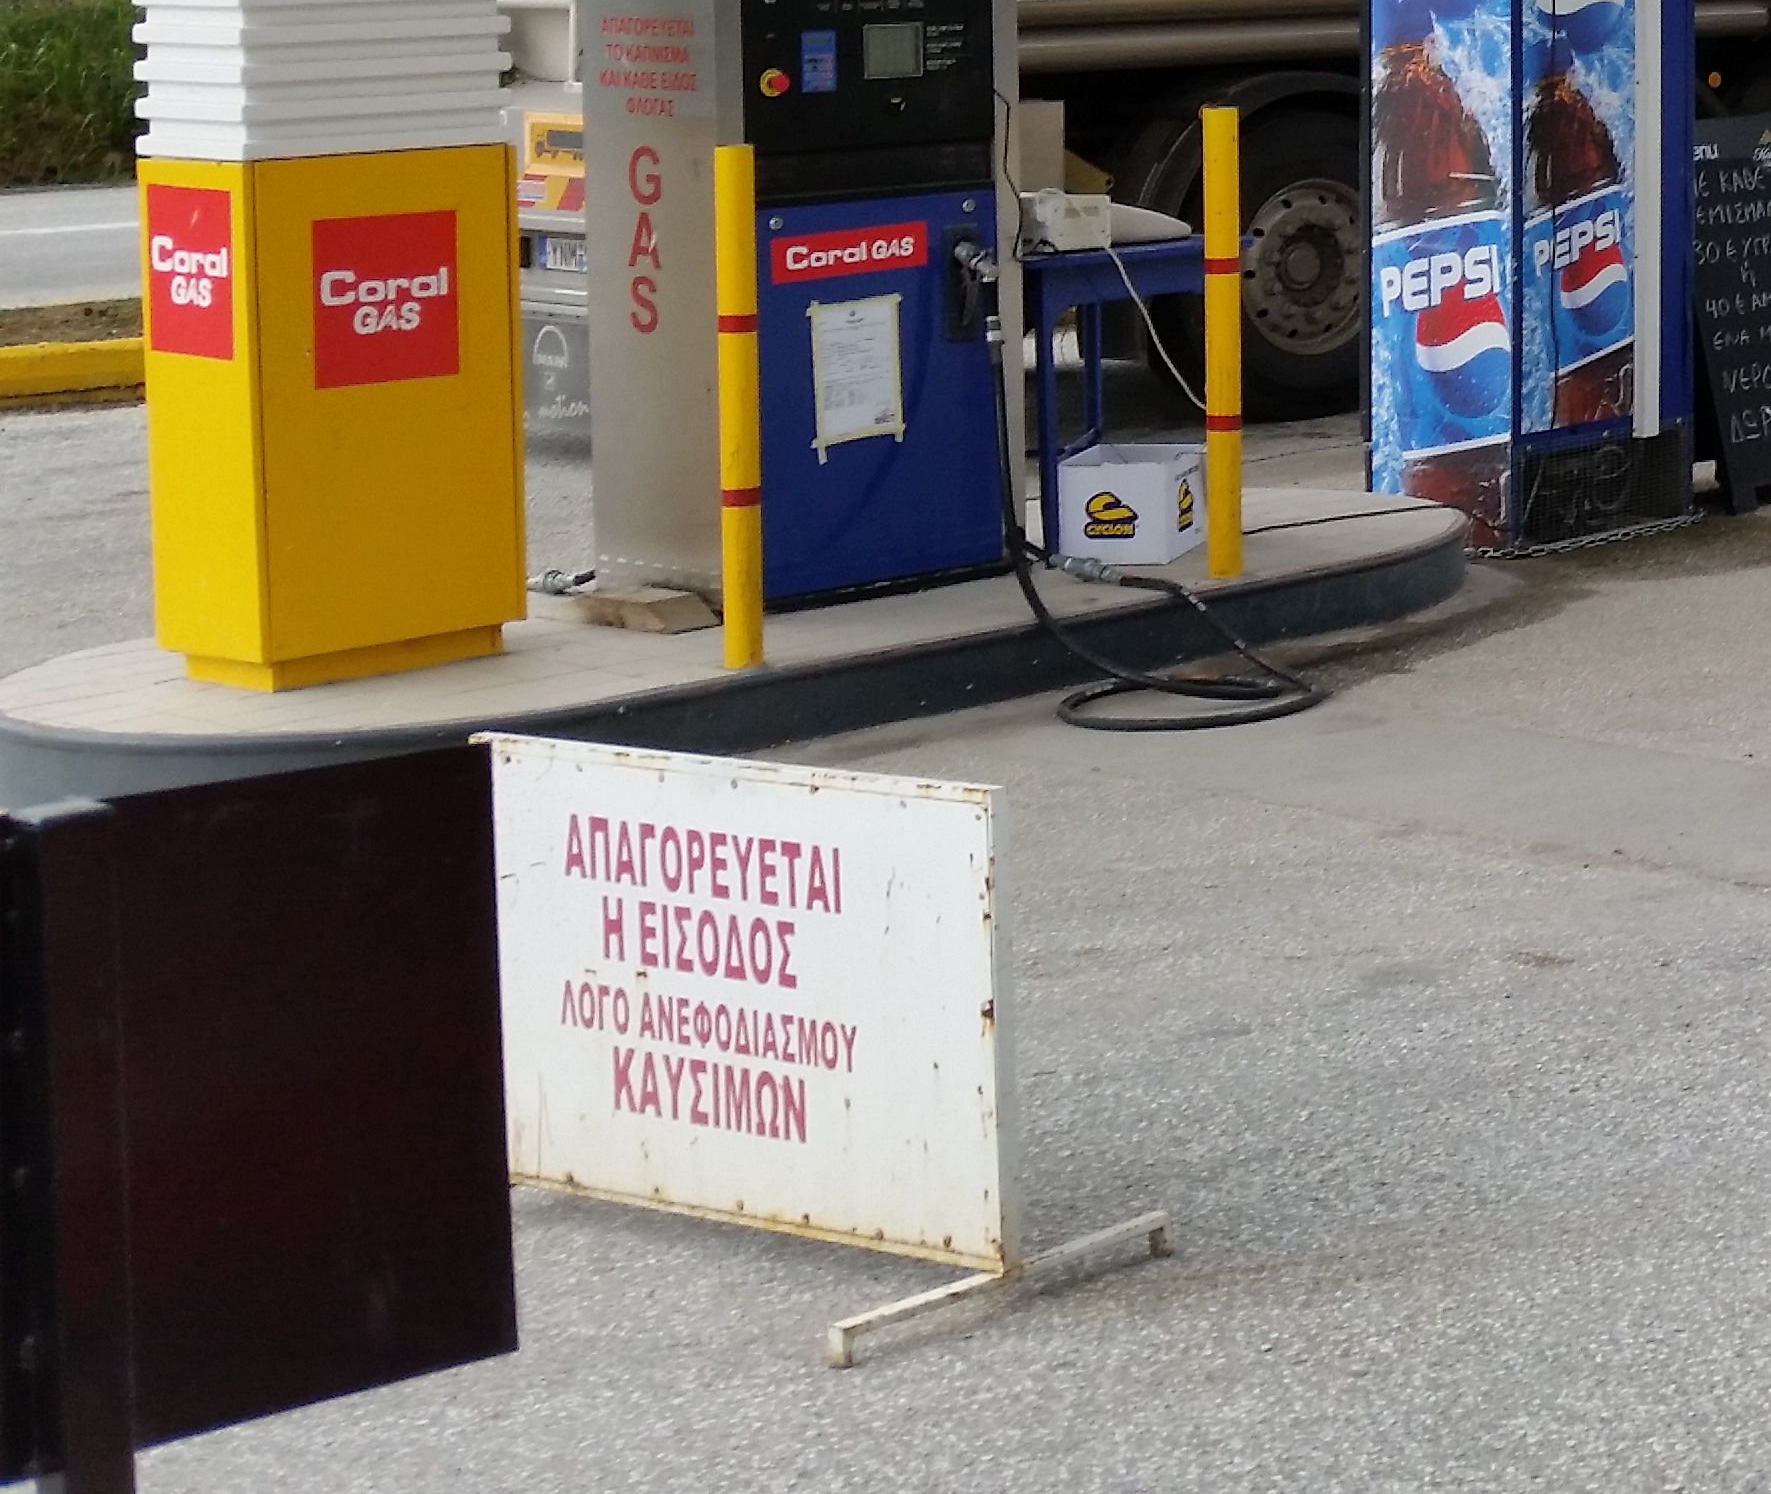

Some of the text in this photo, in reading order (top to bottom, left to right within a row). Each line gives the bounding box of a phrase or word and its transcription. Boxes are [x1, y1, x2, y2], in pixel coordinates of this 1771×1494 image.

[1693, 143, 1719, 161] enu
[152, 235, 229, 278] Coral
[628, 145, 663, 334] GAS
[785, 235, 916, 271] Coral GAS
[1534, 207, 1622, 277] PEPSI
[170, 275, 213, 308] GAS
[320, 266, 450, 307] Coral
[1380, 243, 1501, 319] PEPSI
[353, 300, 422, 336] GAS
[564, 813, 842, 914] ΑΠΑΓΟΡΕΥΕΤΑΙ
[602, 895, 798, 989] Η ΕΙΣΟΔΟΣ
[561, 979, 858, 1073] ΛΟΓΟ ΑΝΕΦΟΔΙΑΣΜΟΥ
[613, 1045, 807, 1144] ΚΑΥΣΙΜΩΝ
